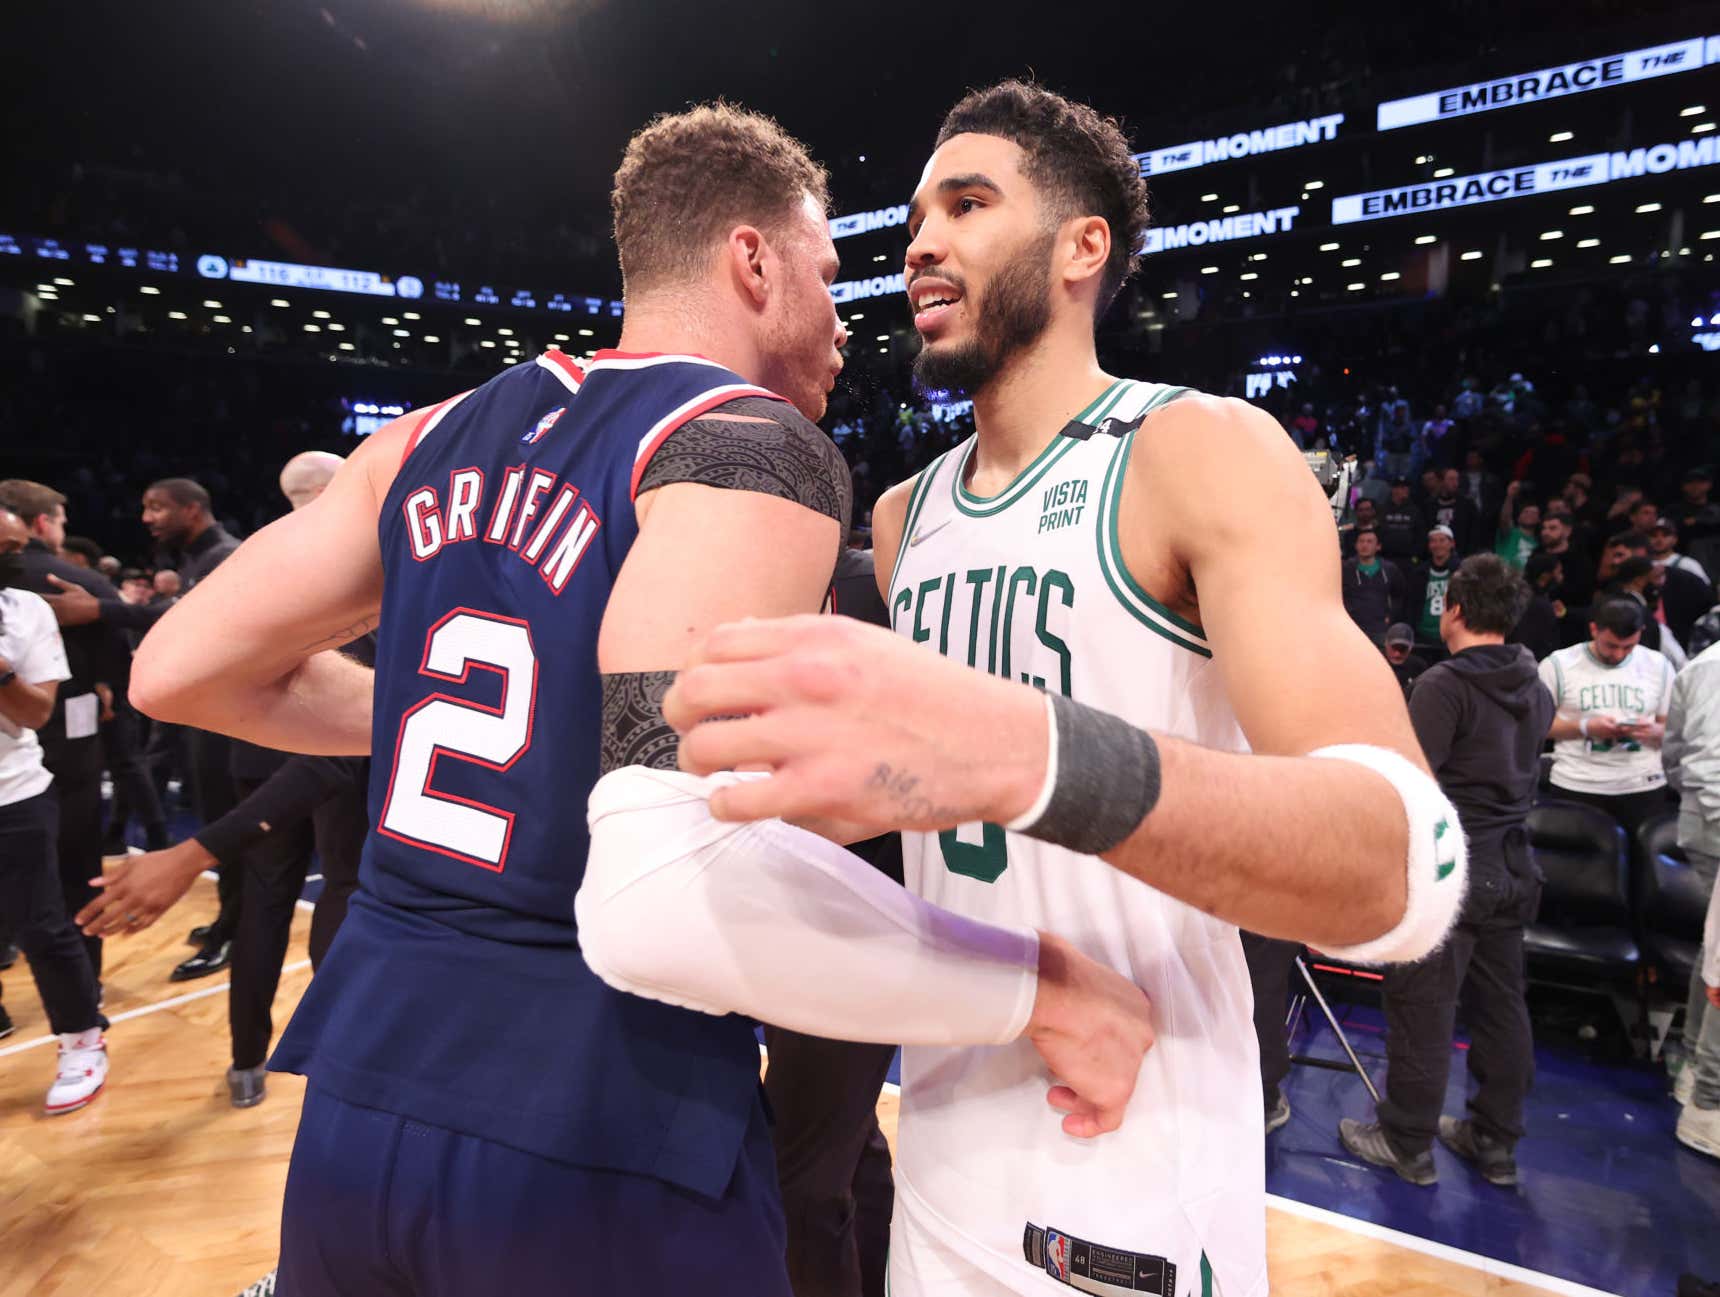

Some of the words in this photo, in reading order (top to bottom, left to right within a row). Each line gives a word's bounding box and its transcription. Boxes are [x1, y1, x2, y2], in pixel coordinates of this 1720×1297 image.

[1437, 57, 1625, 115] EMBRACE
[1641, 50, 1687, 70] THE
[1162, 151, 1192, 166] THE
[1203, 113, 1345, 163] MOMENT
[1361, 170, 1536, 216] EMBRACE
[1550, 165, 1593, 184] THE
[1611, 135, 1720, 179] MOM
[1165, 206, 1300, 249] MOMENT
[853, 273, 906, 299] MOM
[1042, 480, 1088, 513] VISTA
[1038, 506, 1084, 534] PRINT
[1580, 684, 1646, 713] CELTICS
[377, 606, 538, 873] 2
